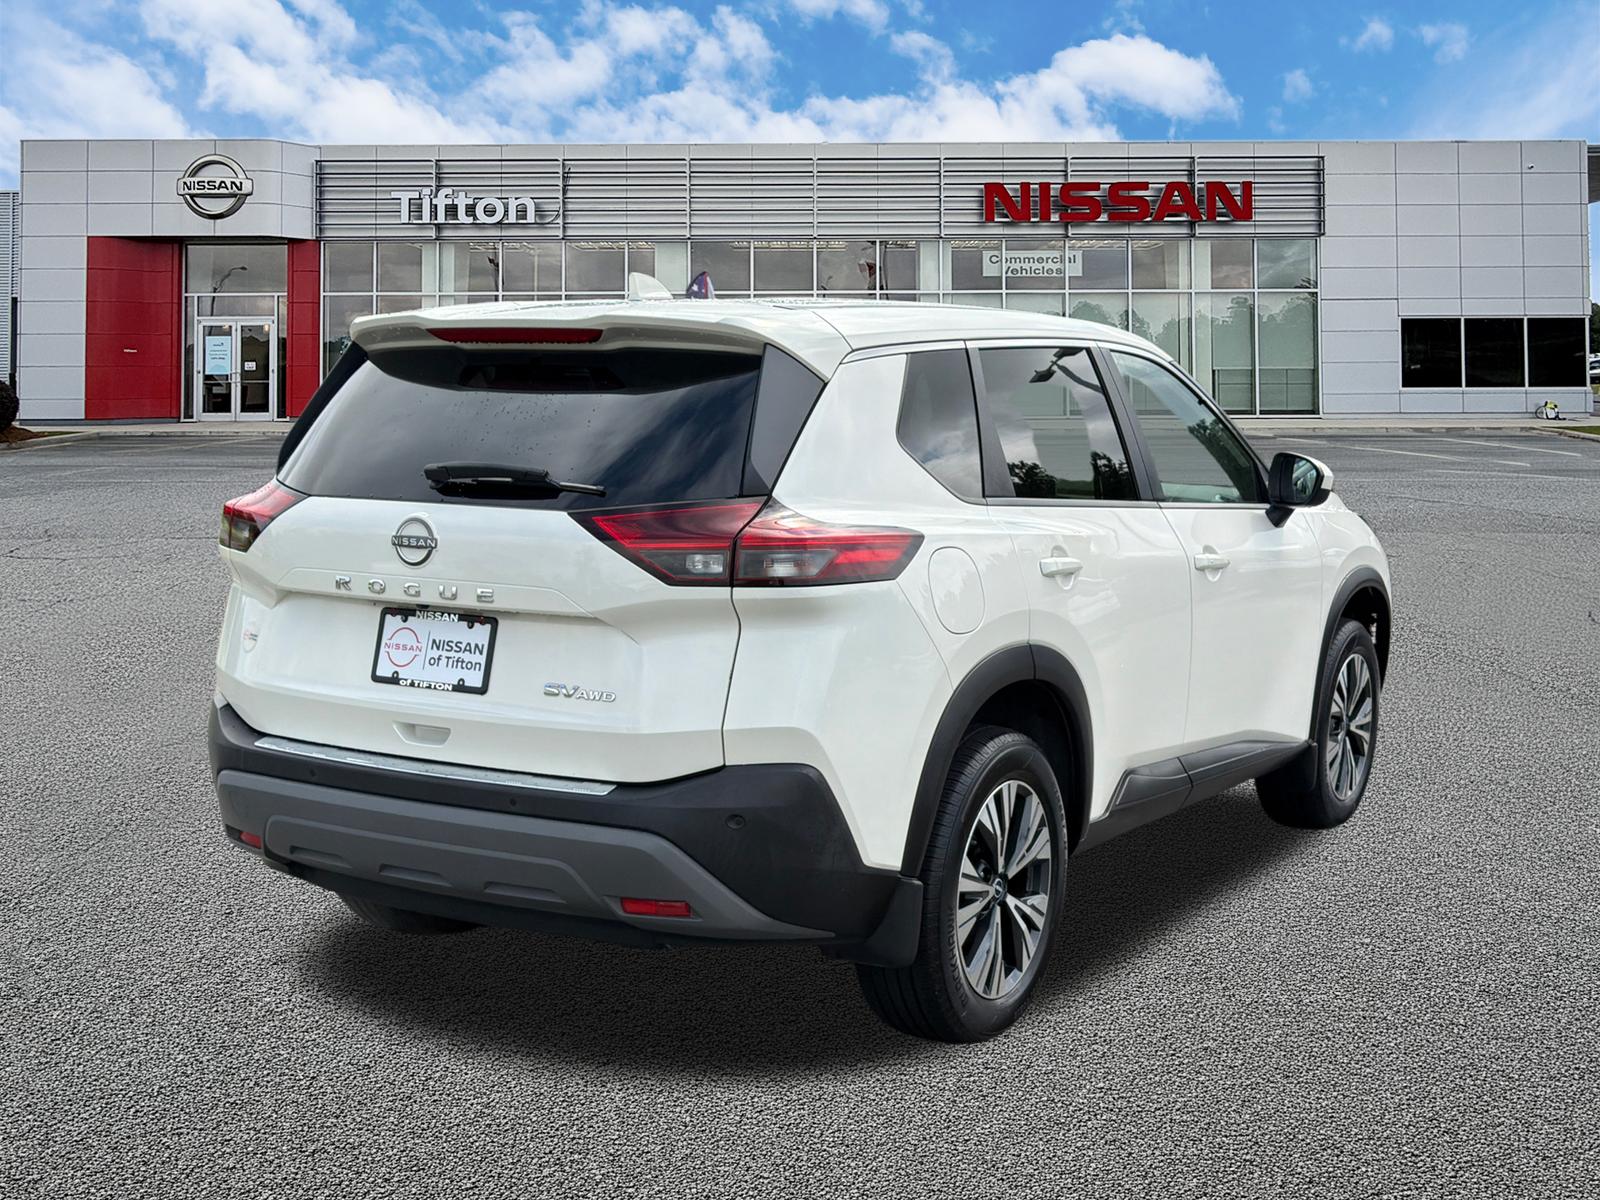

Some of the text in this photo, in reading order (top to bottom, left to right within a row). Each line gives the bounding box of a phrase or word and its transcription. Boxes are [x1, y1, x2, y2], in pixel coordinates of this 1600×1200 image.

[183, 180, 243, 191] NISSAN
[391, 187, 536, 224] Tifton
[983, 181, 1253, 222] NISSAN
[989, 254, 1077, 265] Cmmercil
[392, 536, 436, 548] NISSAN
[335, 575, 495, 603] ROGUE
[416, 610, 459, 622] NISSAN
[384, 642, 422, 652] NISSAN
[431, 638, 484, 656] NISSAN
[428, 654, 482, 672] of Tifton
[413, 680, 453, 691] TIFTON
[544, 682, 616, 703] SV AWD
